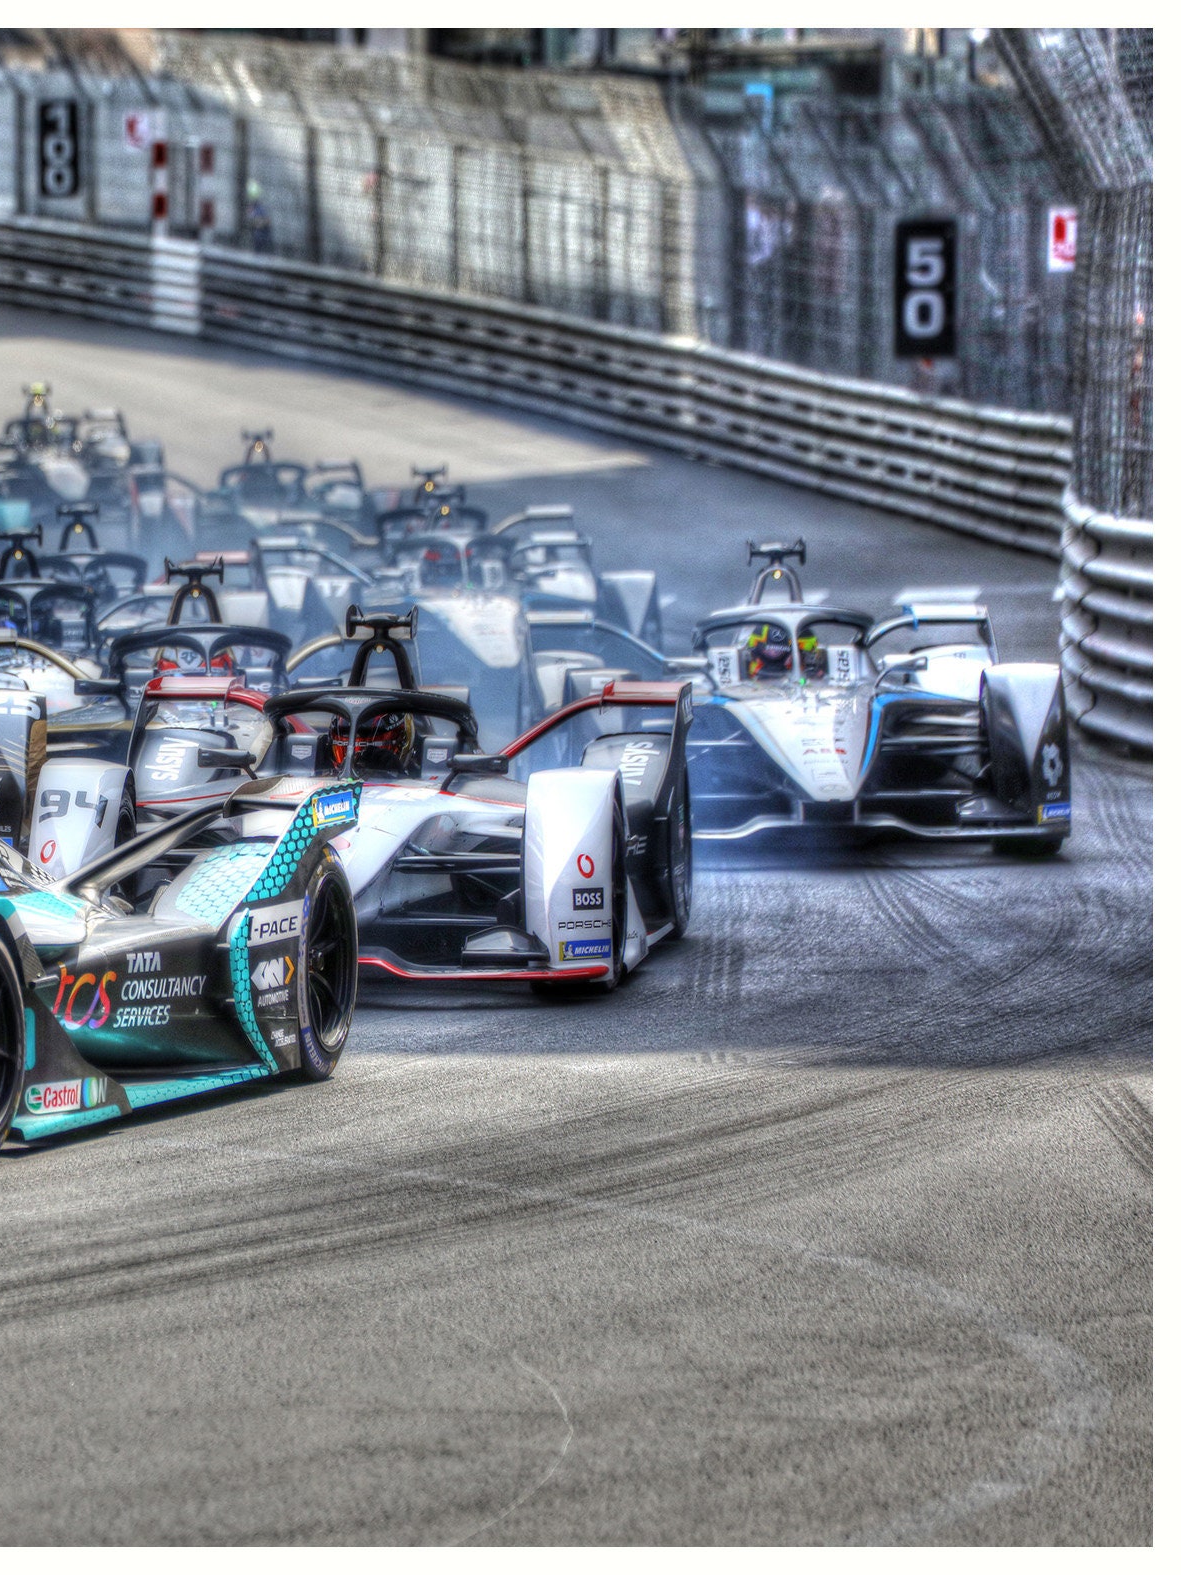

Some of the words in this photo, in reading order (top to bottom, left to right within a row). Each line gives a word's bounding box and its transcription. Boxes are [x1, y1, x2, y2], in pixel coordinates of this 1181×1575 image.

[43, 106, 75, 193] 100
[903, 237, 946, 339] 50
[38, 789, 108, 828] 94
[575, 893, 602, 906] BOSS
[248, 916, 298, 941] I-PACE
[127, 951, 161, 974] TATA
[575, 945, 610, 955] MICHELIN
[121, 975, 206, 1001] CONSULTANCY
[113, 1005, 171, 1028] SERVICES
[43, 1084, 79, 1109] Castrol
